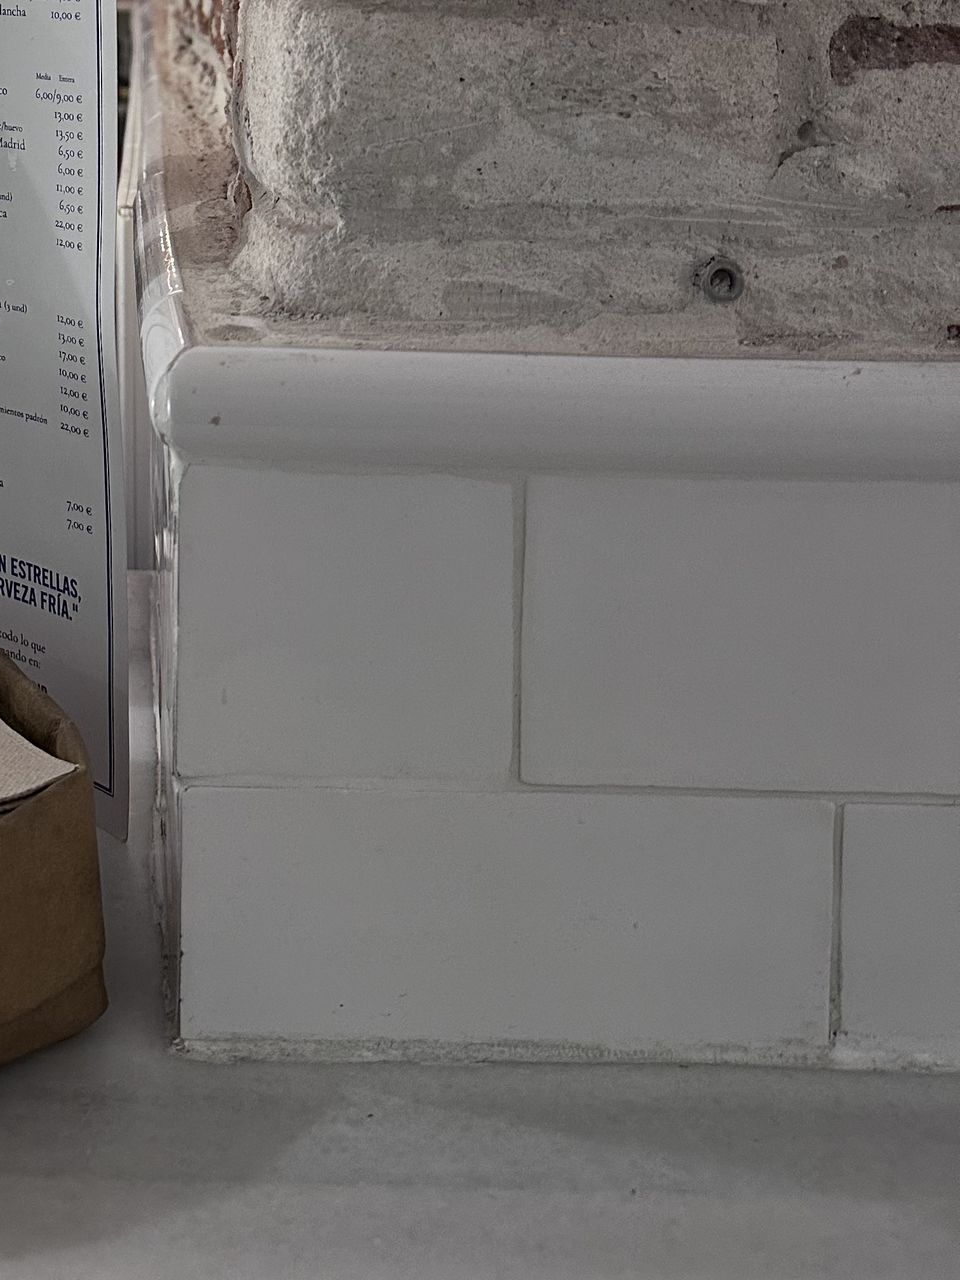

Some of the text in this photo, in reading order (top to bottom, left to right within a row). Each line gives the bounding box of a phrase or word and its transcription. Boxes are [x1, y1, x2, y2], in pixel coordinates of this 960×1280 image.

[55, 219, 83, 233] 22,00 €
[10, 556, 82, 604] ESTRELLAS,
[40, 590, 79, 622] FRÍA."
[20, 633, 29, 647] lo
[30, 641, 46, 655] que
